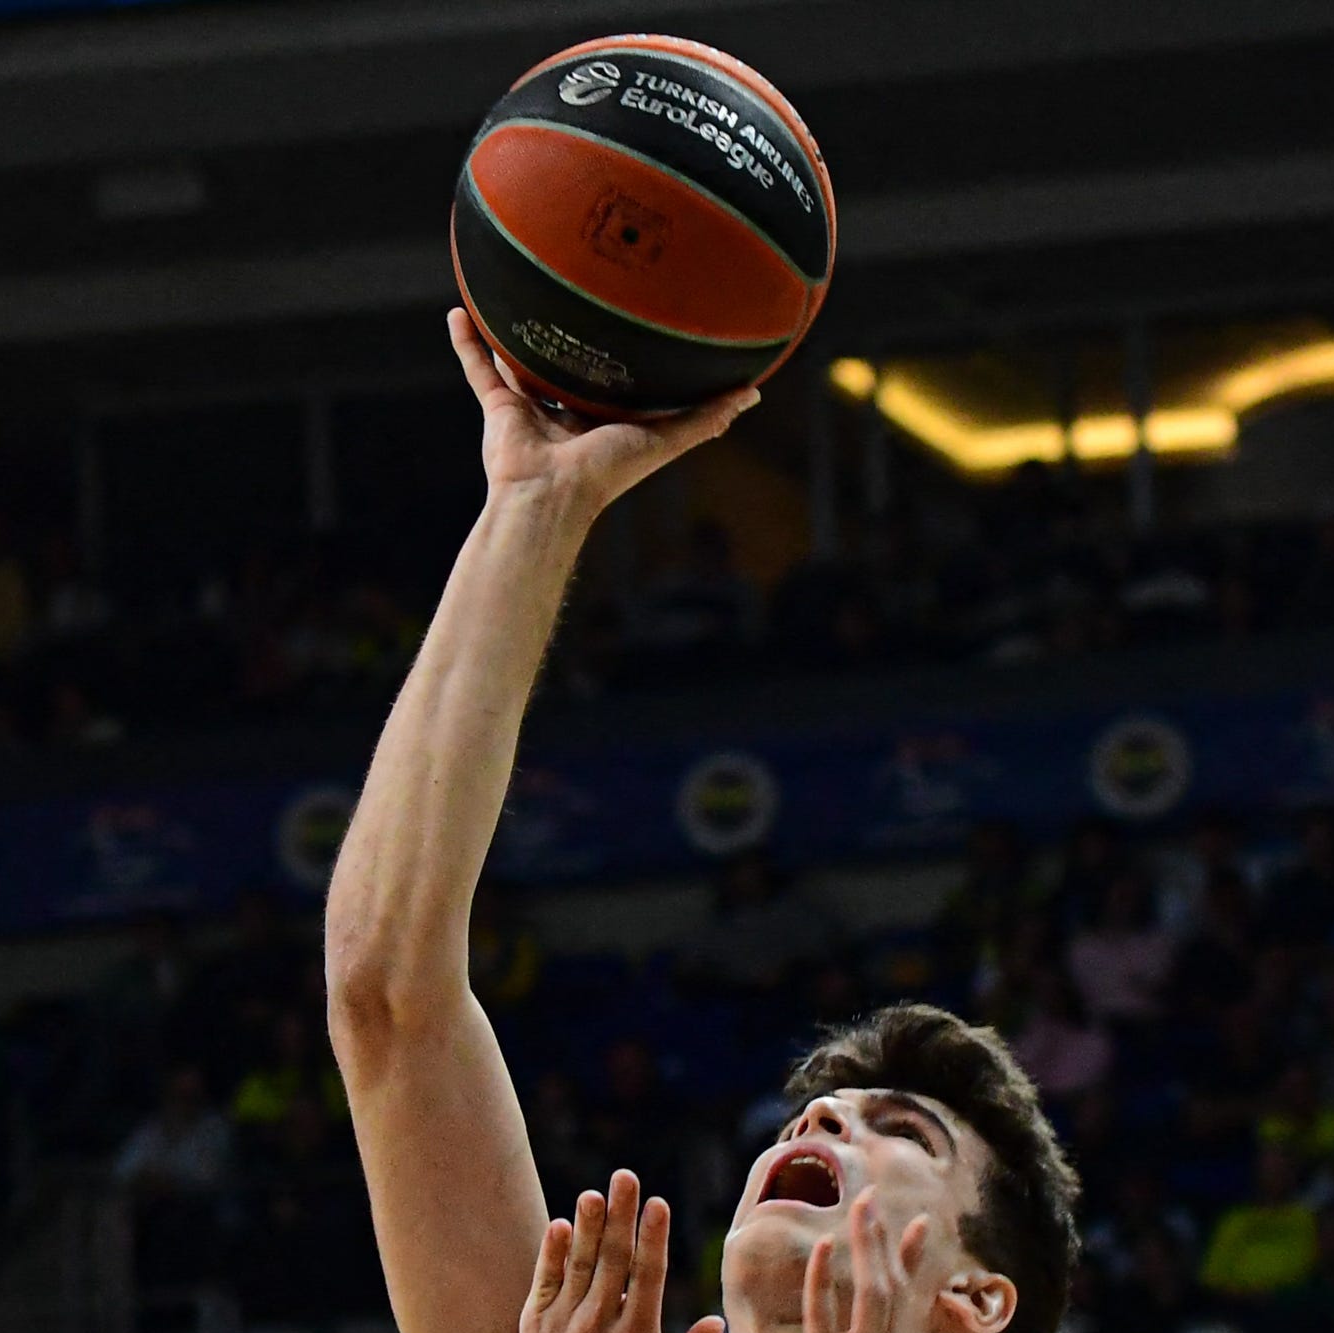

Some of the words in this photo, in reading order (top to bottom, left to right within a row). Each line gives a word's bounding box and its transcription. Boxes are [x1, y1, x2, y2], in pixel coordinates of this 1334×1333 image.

[620, 87, 775, 190] EuroLeague
[635, 71, 739, 129] TURKISH
[739, 124, 815, 214] AIRLINES
